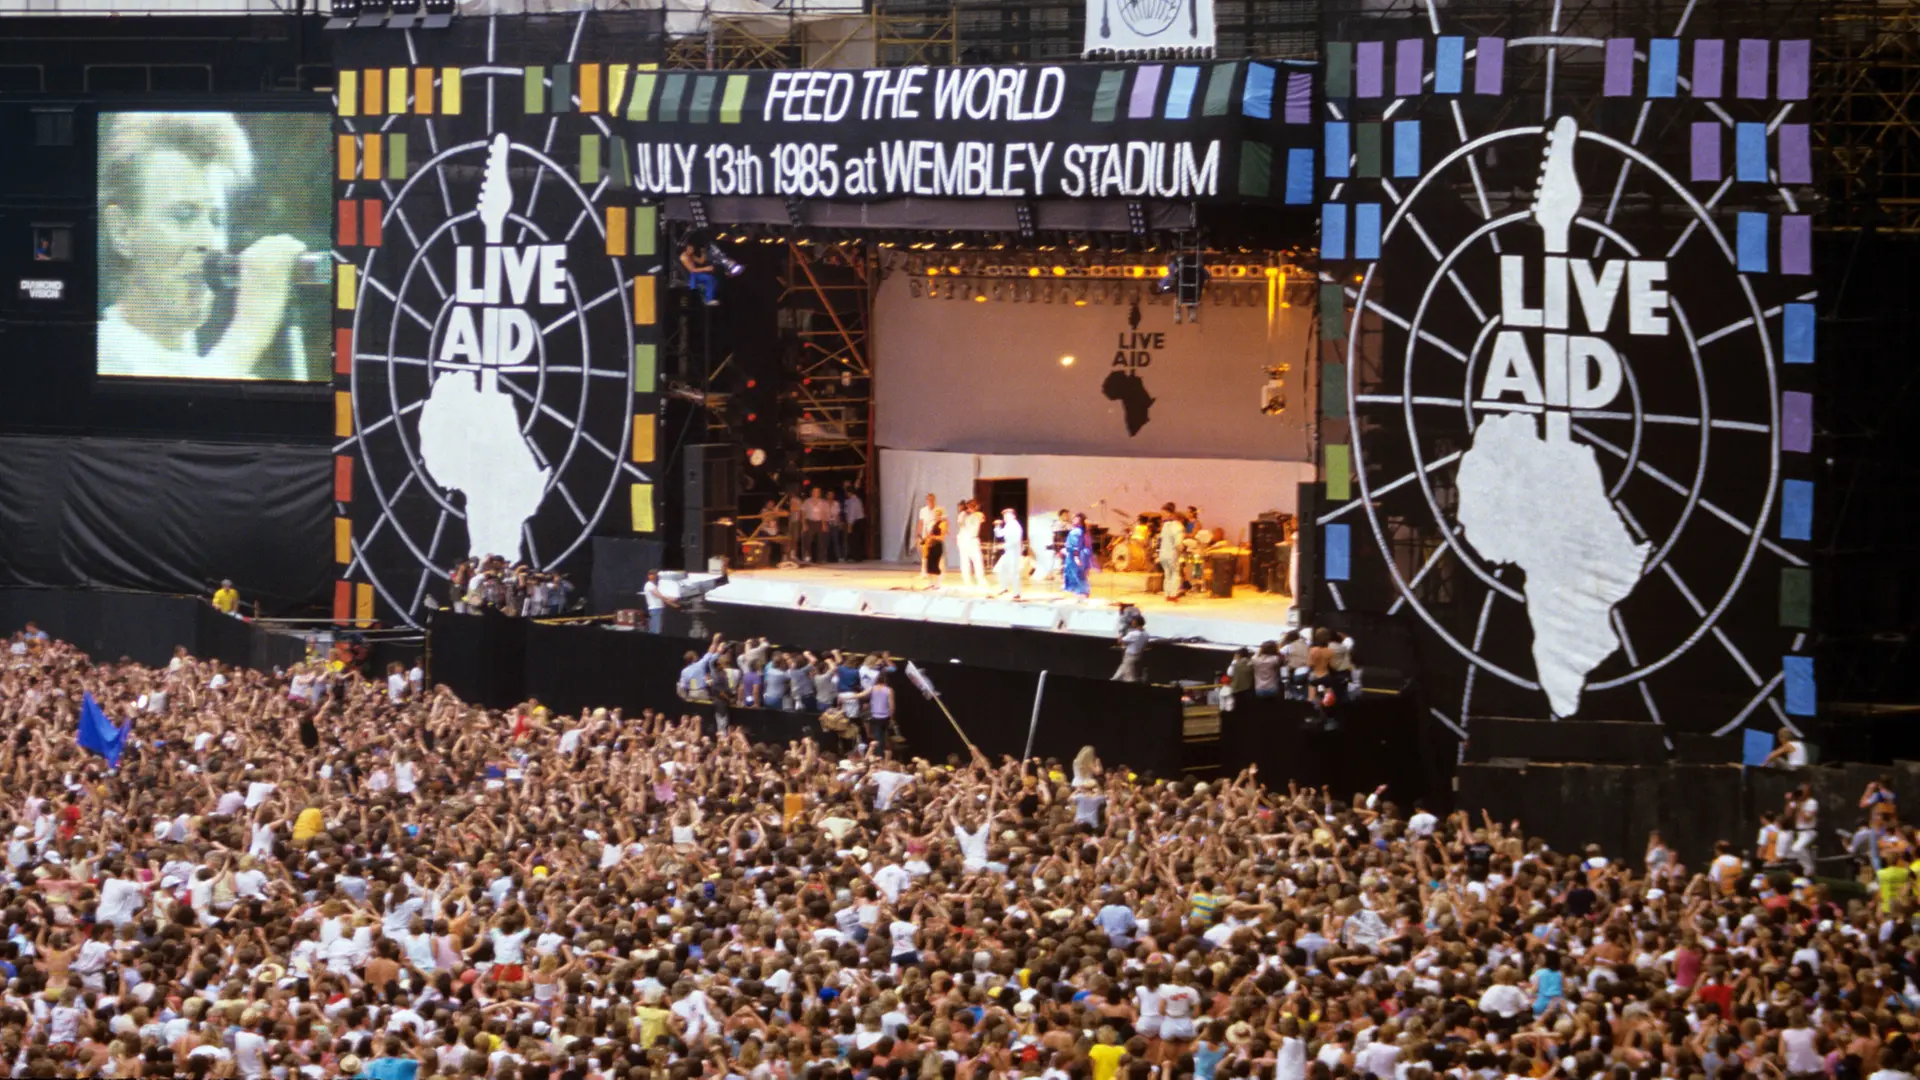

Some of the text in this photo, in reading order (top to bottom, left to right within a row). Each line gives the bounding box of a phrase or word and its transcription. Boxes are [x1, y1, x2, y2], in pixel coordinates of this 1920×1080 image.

[763, 66, 1066, 122] FEED THE WORLD
[634, 140, 1221, 197] JULY 13th 1985 at WEMBLEY STADIUM
[456, 244, 567, 304] LIVE
[1500, 255, 1669, 336] LIVE
[439, 305, 535, 365] AID
[1112, 350, 1151, 367] AID
[1118, 332, 1165, 349] LIVE
[1481, 331, 1623, 409] AID
